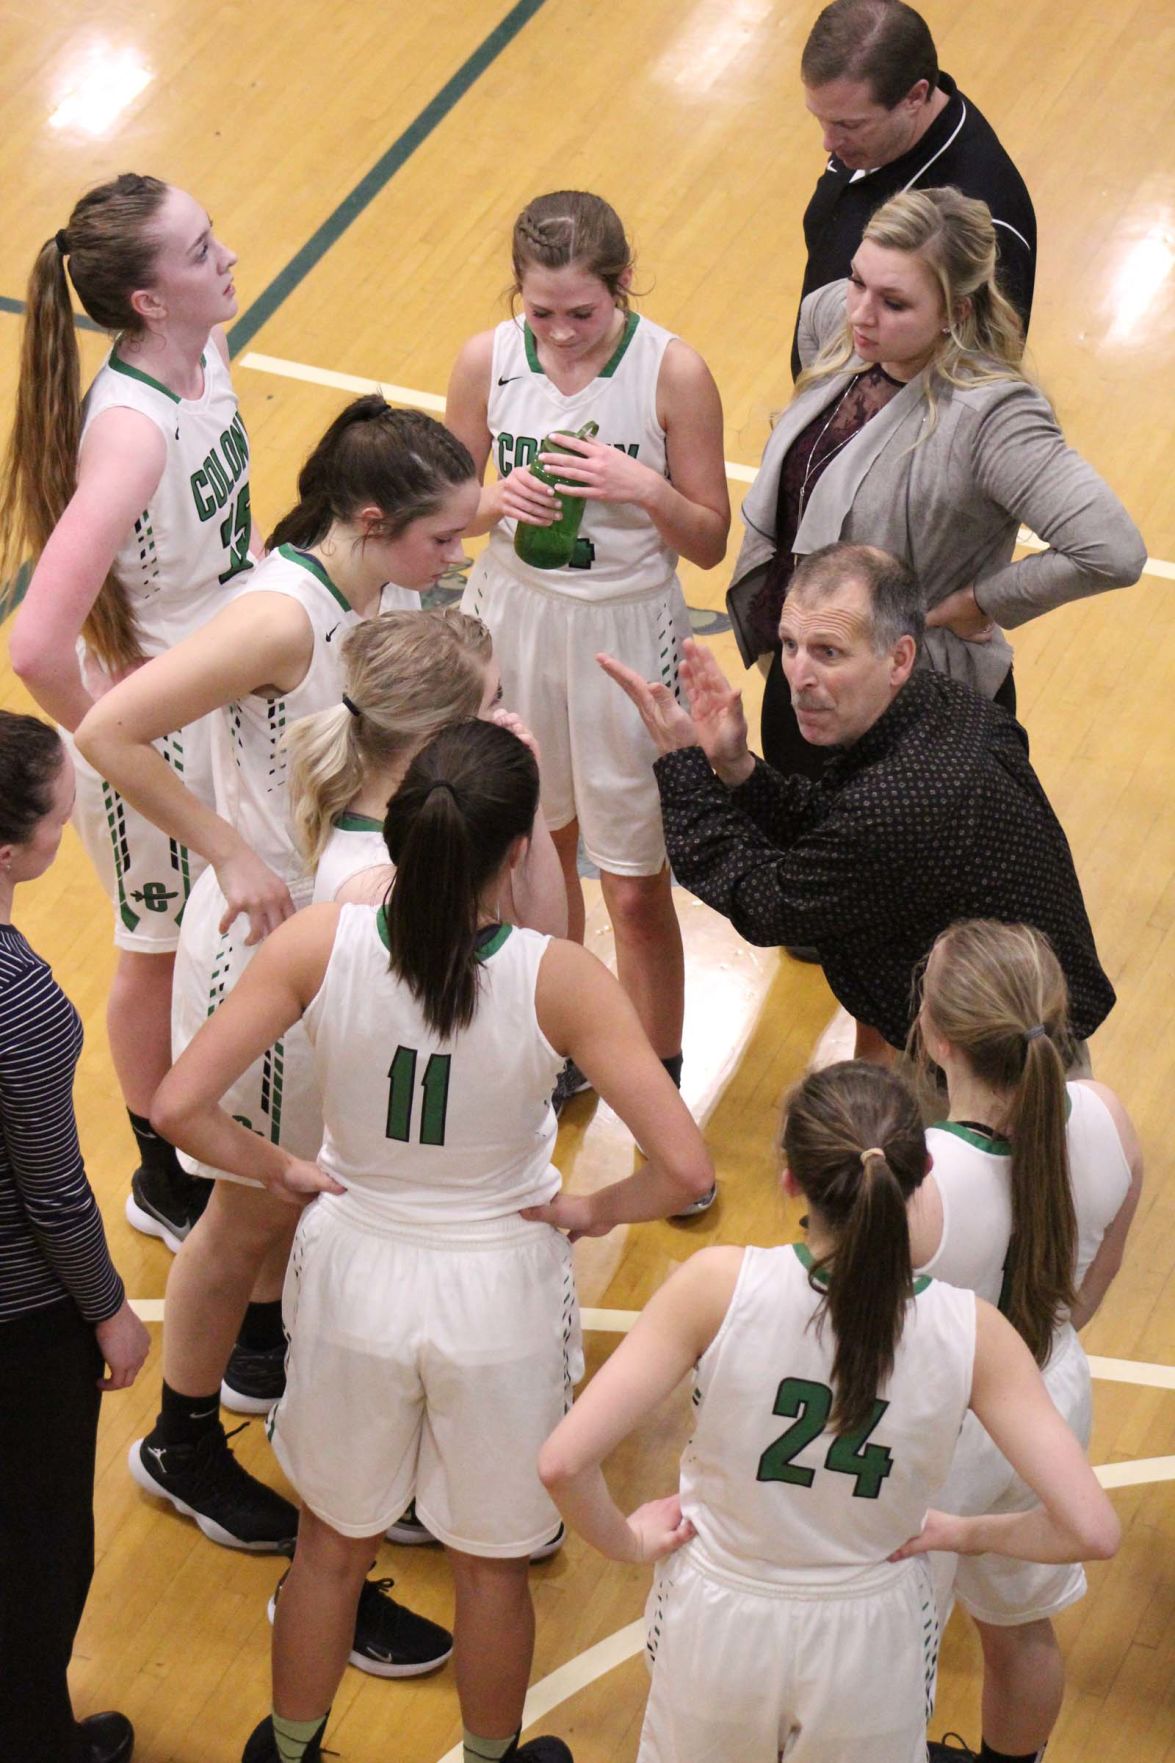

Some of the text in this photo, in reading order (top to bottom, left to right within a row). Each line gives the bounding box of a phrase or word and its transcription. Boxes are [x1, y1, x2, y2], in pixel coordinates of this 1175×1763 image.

[190, 411, 249, 523] COLON
[385, 1044, 452, 1147] 11
[755, 1376, 894, 1499] 24
